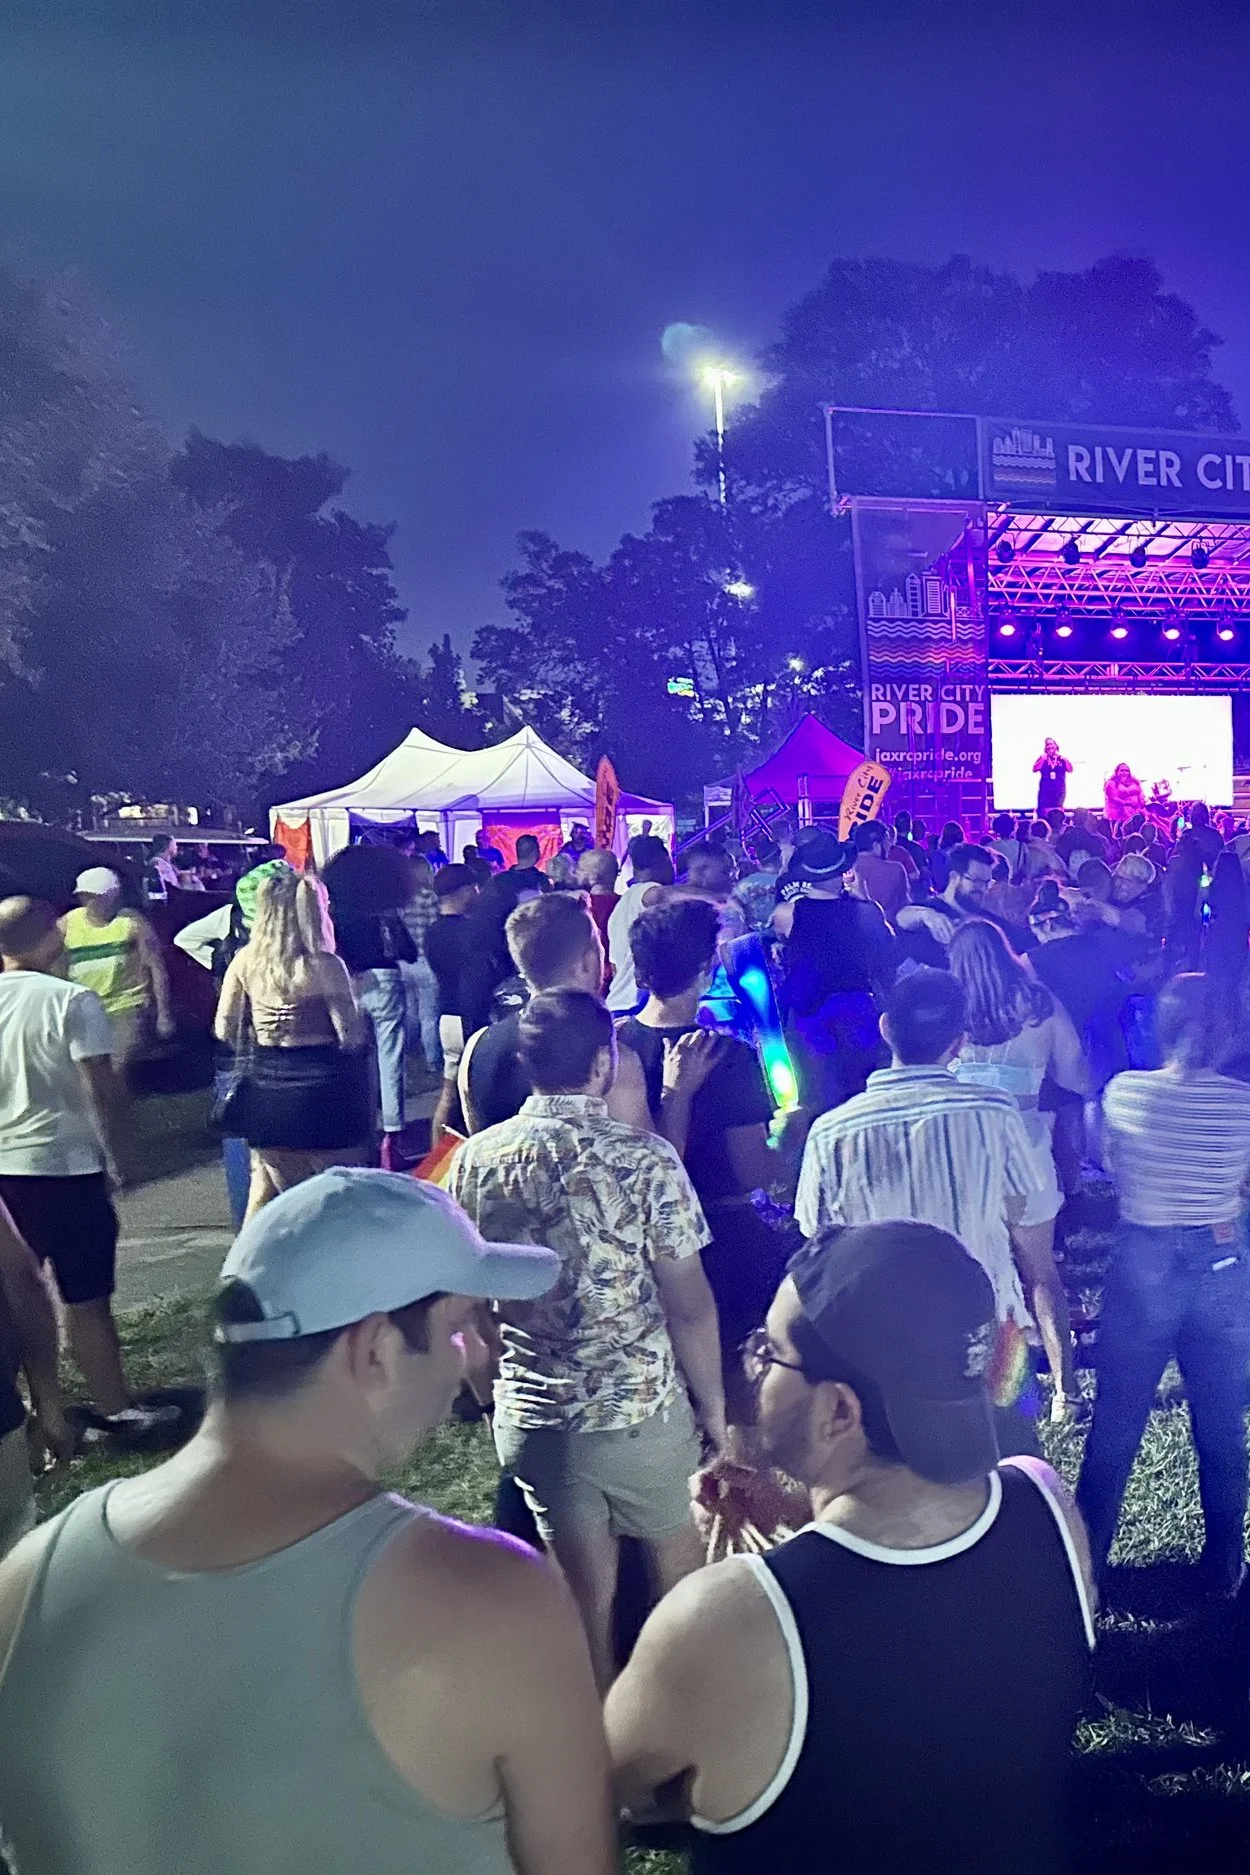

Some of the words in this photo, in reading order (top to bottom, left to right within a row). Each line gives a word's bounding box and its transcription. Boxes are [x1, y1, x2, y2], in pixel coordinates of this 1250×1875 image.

[1067, 444, 1183, 488] RIVER
[871, 683, 933, 701] RIVER
[941, 684, 986, 702] CITY
[871, 701, 985, 735] PRIDE
[875, 748, 982, 764] jaxrcpride.org
